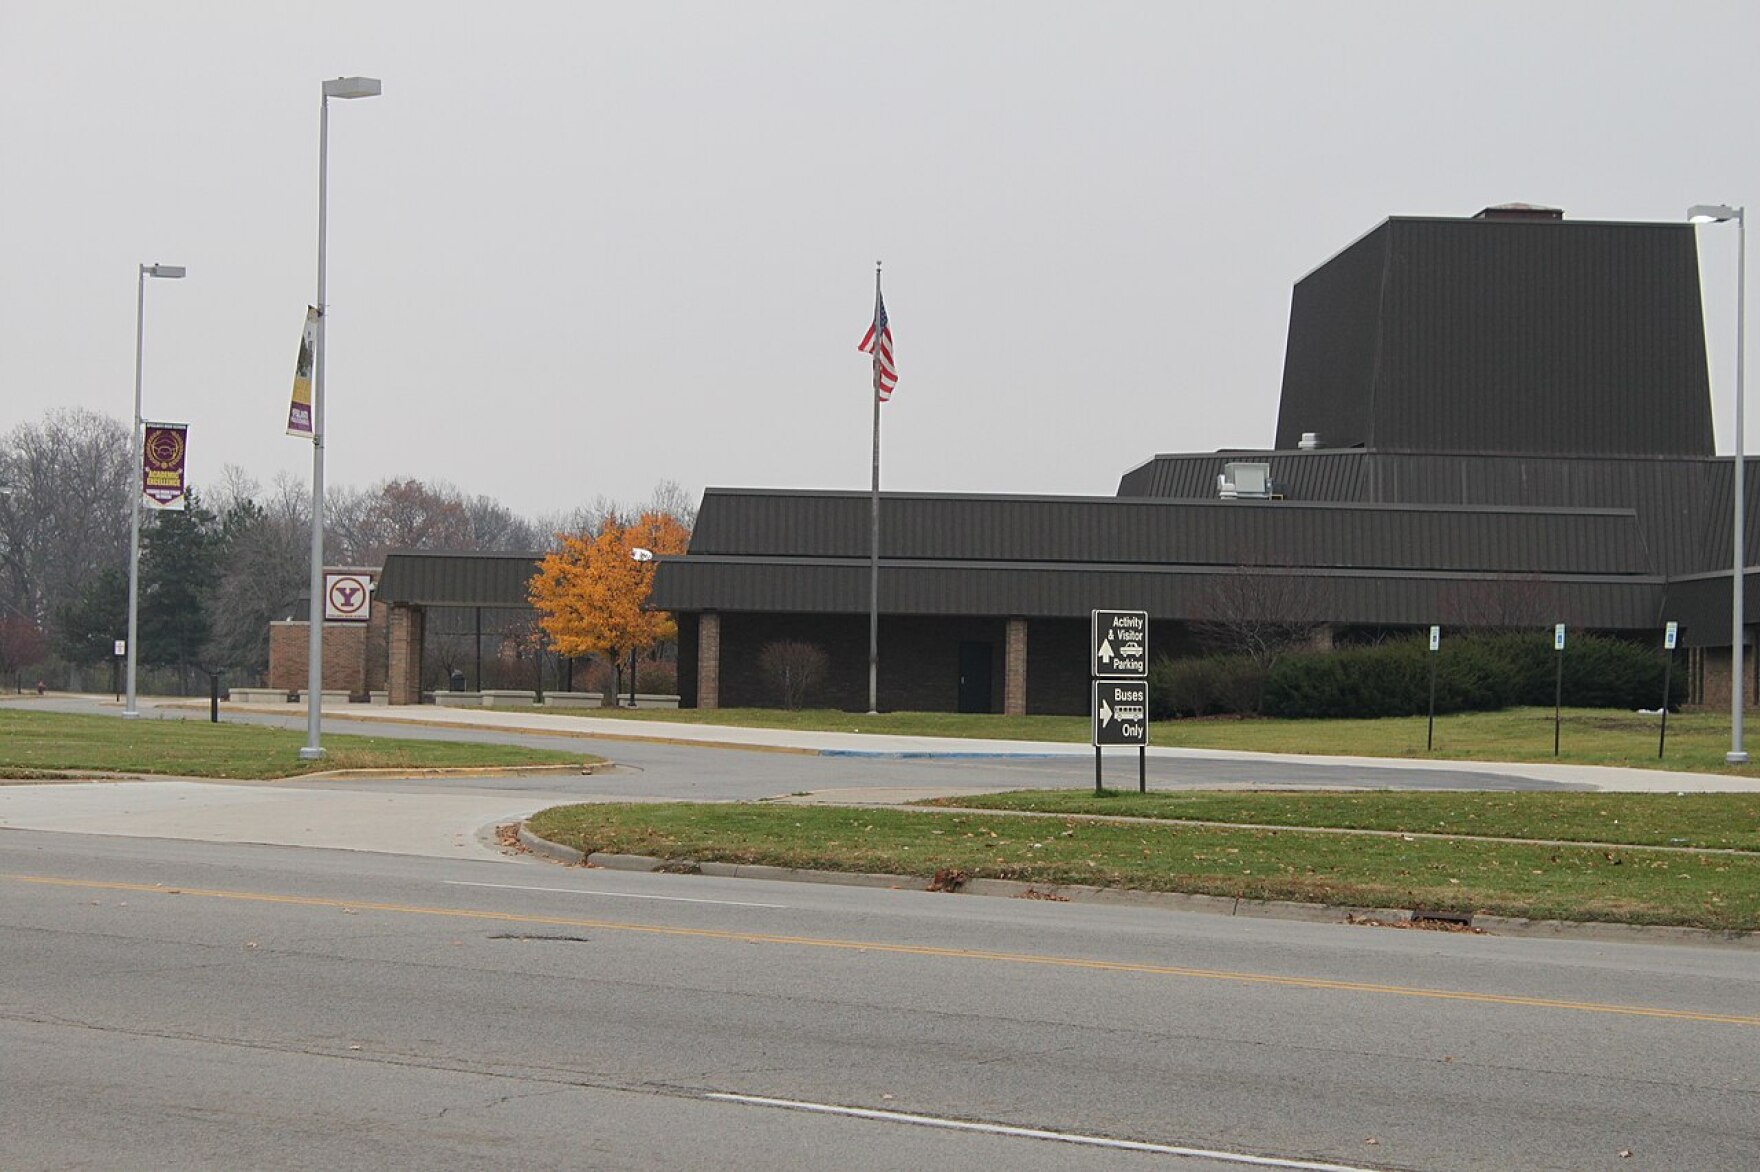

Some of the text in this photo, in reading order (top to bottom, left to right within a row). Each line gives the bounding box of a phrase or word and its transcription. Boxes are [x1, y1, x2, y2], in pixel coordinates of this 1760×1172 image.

[335, 588, 360, 606] Y
[1113, 616, 1143, 630] Activity
[1108, 629, 1143, 640] & Visitor
[1113, 658, 1144, 672] Parking
[1114, 688, 1144, 702] Buses
[1122, 724, 1144, 738] Only
